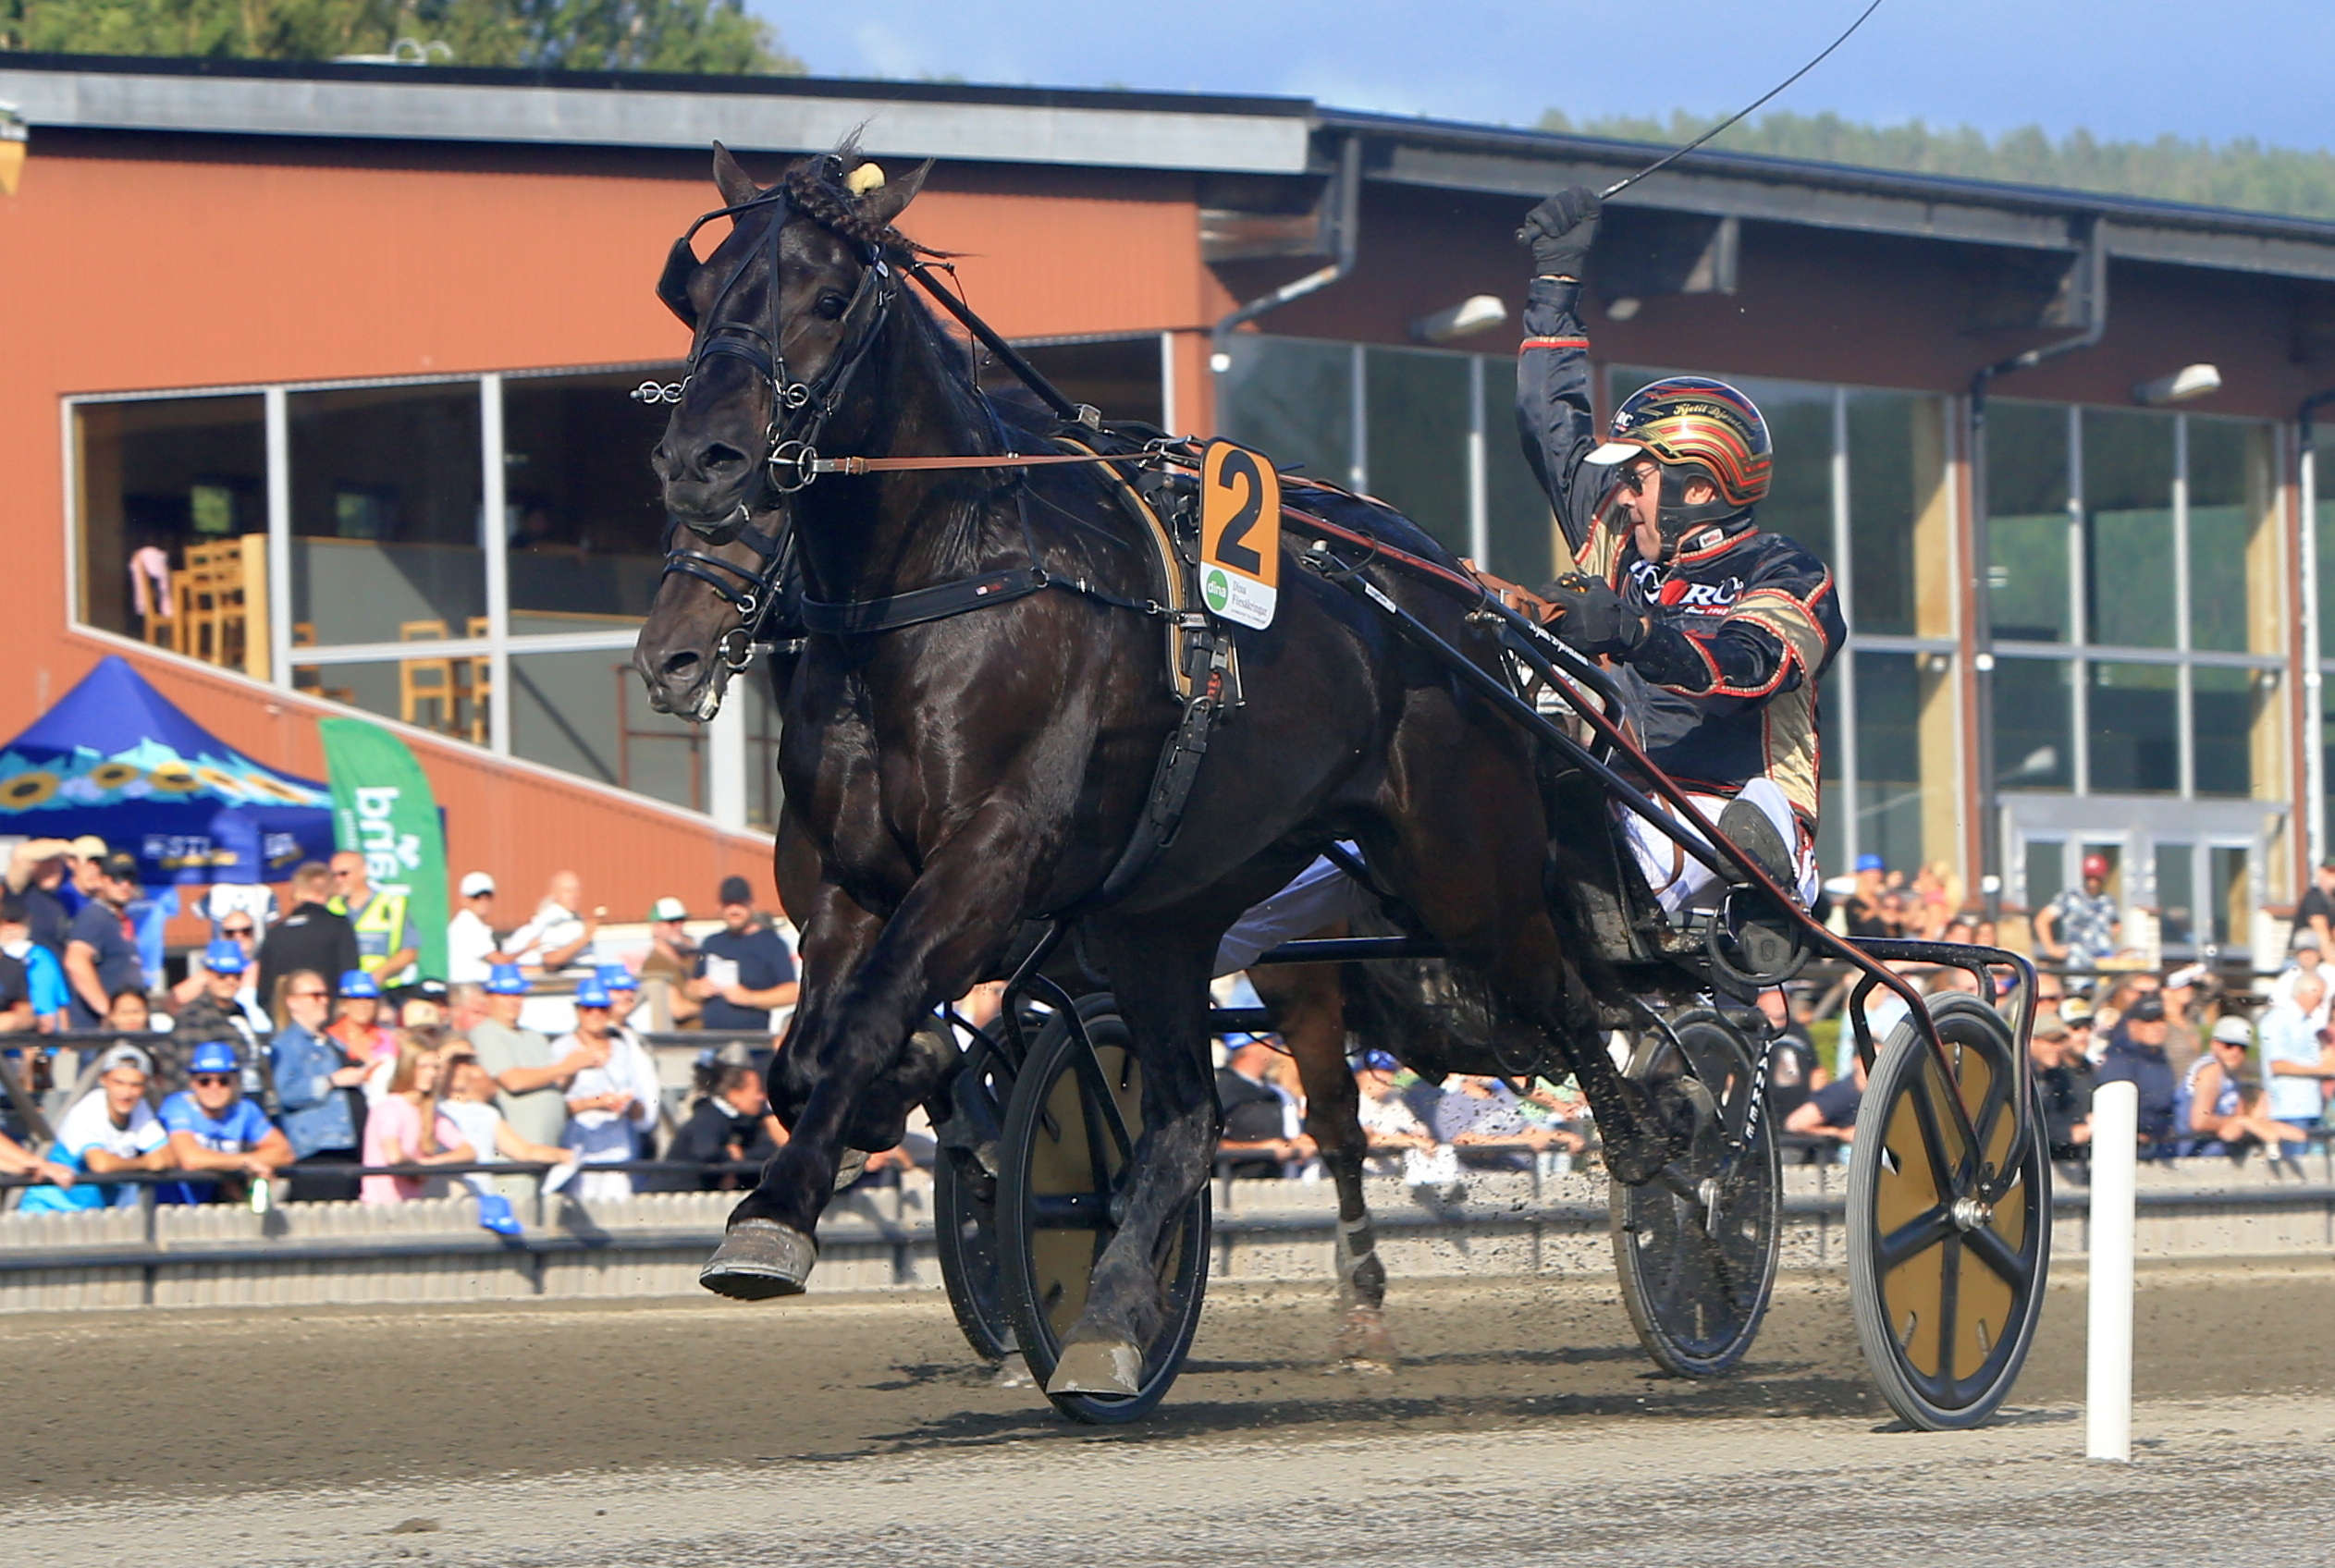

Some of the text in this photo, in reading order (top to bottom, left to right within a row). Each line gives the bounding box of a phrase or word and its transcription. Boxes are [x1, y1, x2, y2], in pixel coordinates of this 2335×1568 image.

[1215, 449, 1263, 576] 2
[1208, 581, 1226, 598] dina
[1745, 1040, 1773, 1139] YANKEE
